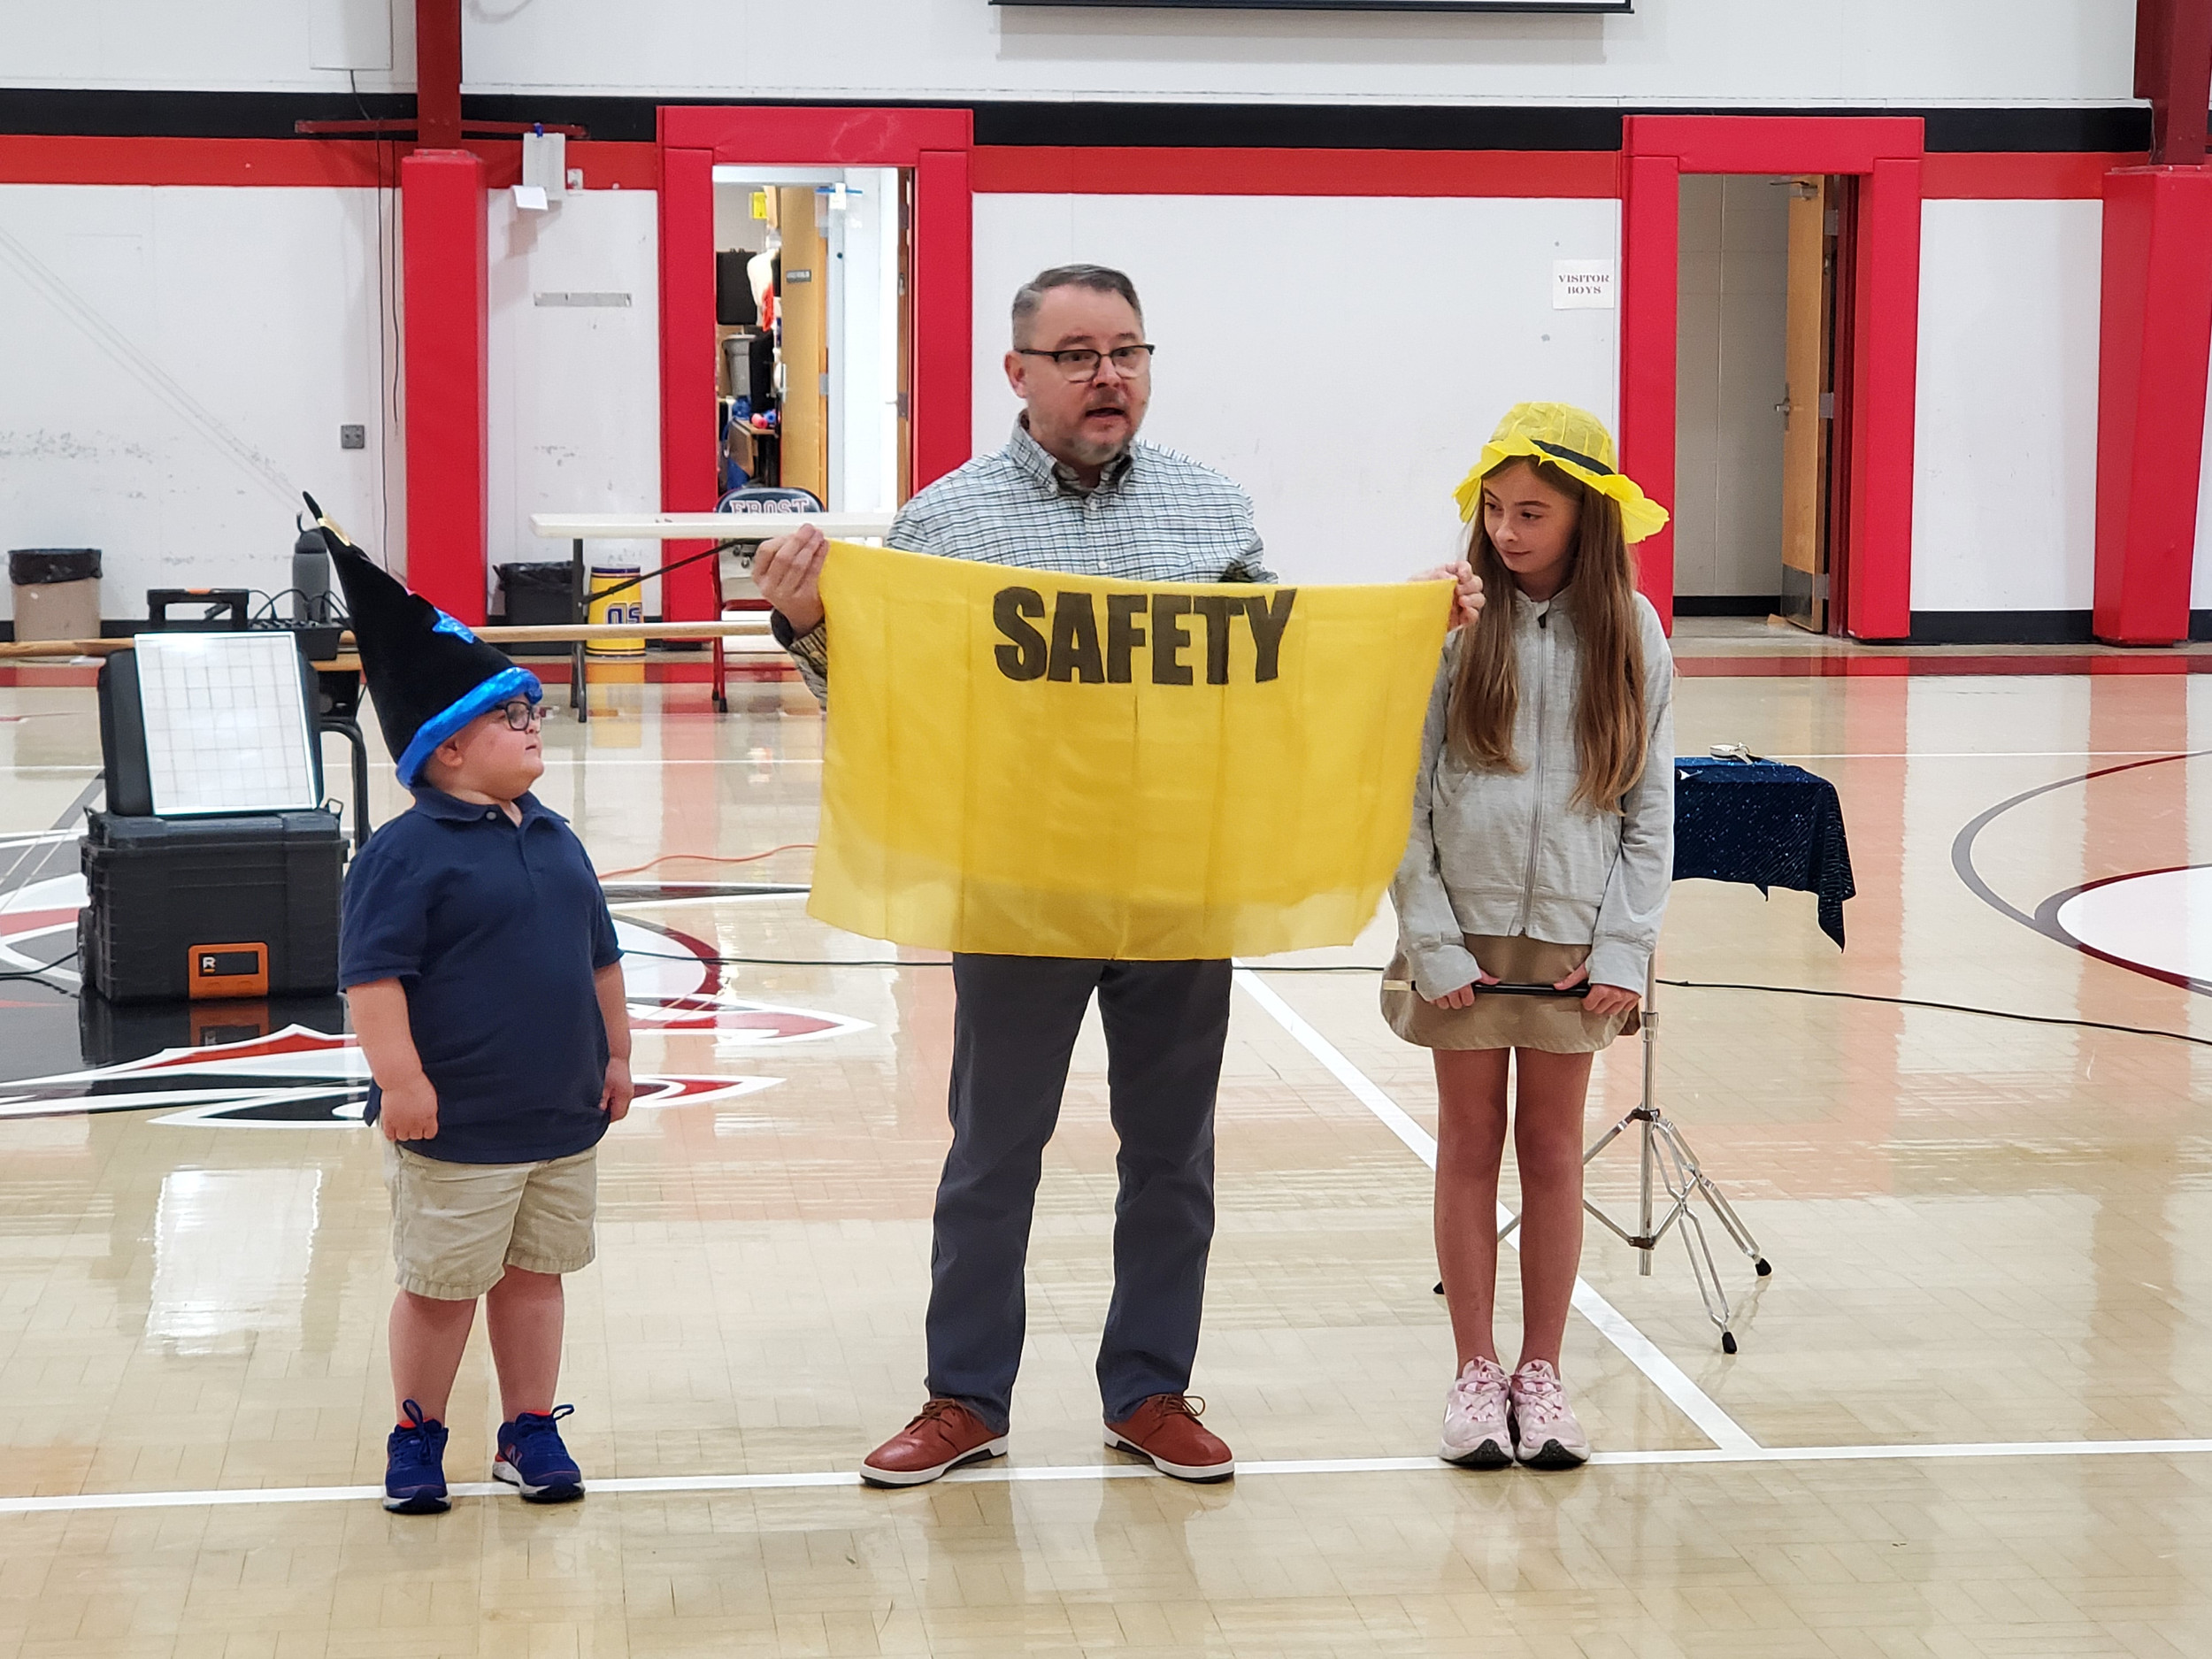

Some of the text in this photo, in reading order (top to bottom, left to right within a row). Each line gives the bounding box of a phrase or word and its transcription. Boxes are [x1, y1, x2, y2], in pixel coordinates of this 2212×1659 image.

[1558, 274, 1609, 283] VISITOR
[1568, 286, 1601, 295] BOYS
[729, 498, 809, 513] FROST
[993, 586, 1297, 686] SAFETY
[202, 956, 217, 969] R
